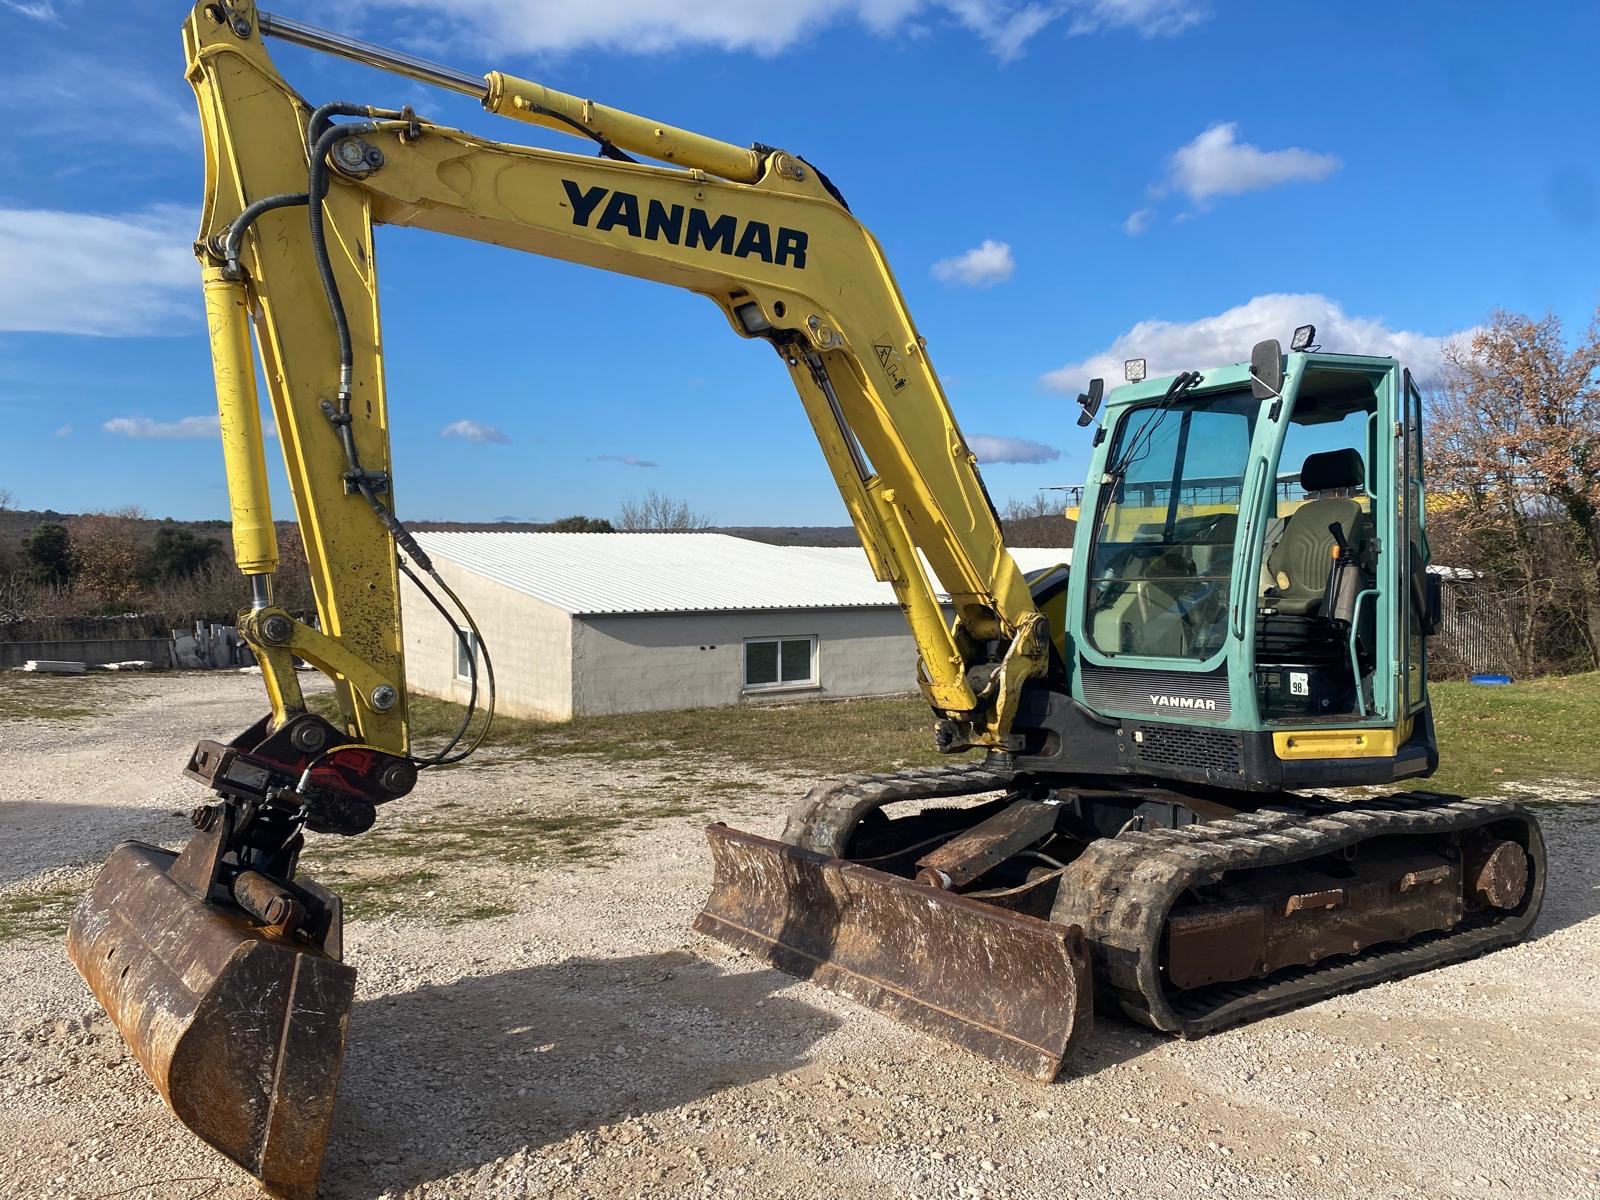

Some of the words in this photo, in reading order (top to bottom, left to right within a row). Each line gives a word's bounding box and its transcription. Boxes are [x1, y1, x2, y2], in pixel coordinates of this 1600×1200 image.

[561, 179, 808, 269] YANMAR
[1292, 682, 1302, 693] 98
[1149, 694, 1216, 710] YANMAR
